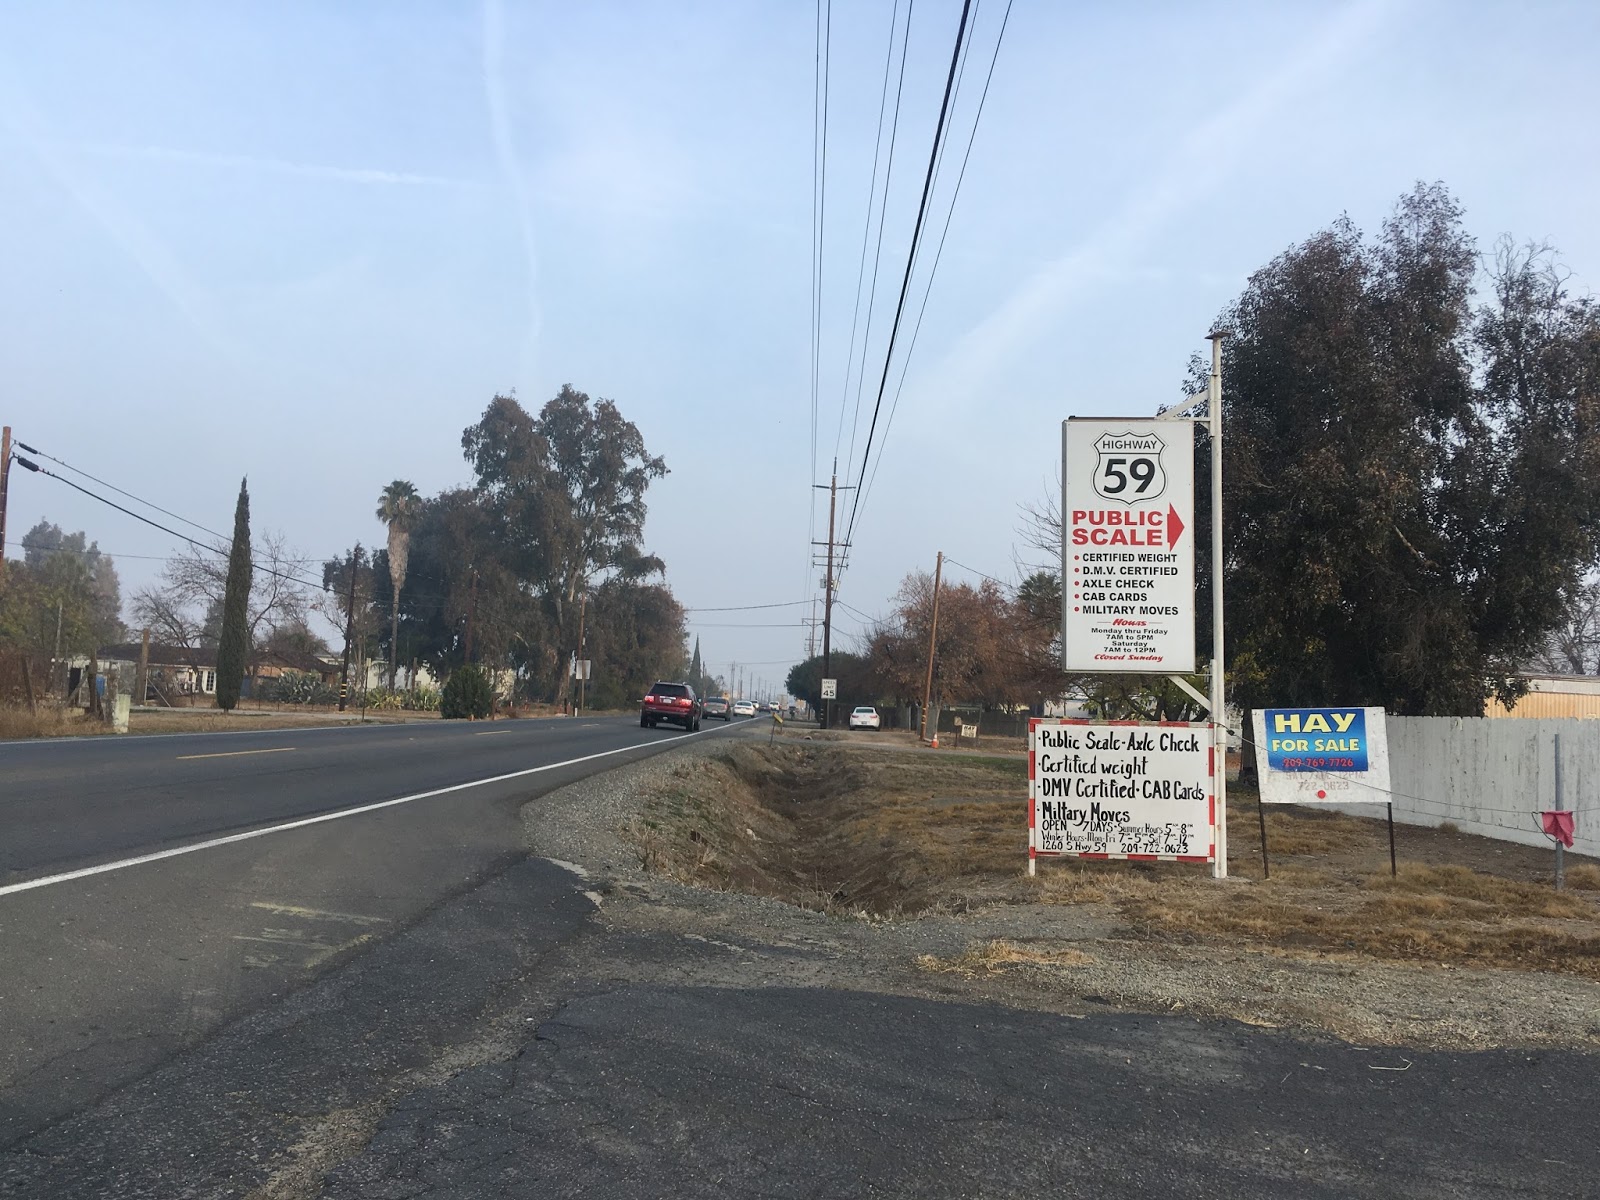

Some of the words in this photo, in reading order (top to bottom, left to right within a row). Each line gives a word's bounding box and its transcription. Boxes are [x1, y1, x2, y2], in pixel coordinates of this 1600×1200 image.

[1102, 440, 1158, 450] HIGHWAY
[1103, 458, 1156, 494] 59
[1072, 510, 1163, 526] PUBLIC
[1072, 528, 1163, 546] SCALE
[1082, 553, 1135, 562] CERTIFIED
[1138, 554, 1178, 563] WEIGHT
[1082, 566, 1116, 575] D.M.V.
[1120, 567, 1178, 576] CERTIFIED
[1082, 579, 1112, 588] AXLE
[1115, 580, 1155, 589] CHECK
[1082, 592, 1106, 601] CAB
[1109, 592, 1148, 602] CARDS
[1082, 605, 1136, 615] MILITARY
[1139, 606, 1179, 616] MOVES
[1112, 618, 1148, 627] Hours
[1091, 627, 1122, 635] Monday
[1143, 628, 1169, 636] Friday
[1112, 640, 1148, 648] Saturday
[1094, 653, 1126, 661] Closed
[1127, 654, 1163, 663] Sunday
[823, 689, 835, 697] 45
[1274, 713, 1356, 733] HAY
[1042, 730, 1080, 750] Public
[1160, 733, 1200, 752] Check
[1271, 739, 1309, 752] FOR
[1315, 738, 1360, 752] SALE
[1041, 754, 1097, 774] Certified
[1101, 756, 1149, 779] weight
[1283, 757, 1354, 768] 209-769-7726
[1042, 777, 1072, 797] DMV
[1142, 780, 1171, 800] CAB
[1173, 780, 1205, 801] Cards
[1090, 802, 1130, 822] Moves
[1042, 819, 1068, 831] OPEN
[1042, 840, 1063, 851] 1260
[1066, 841, 1073, 851] S
[1075, 841, 1092, 853] Hwy
[1094, 841, 1107, 853] 59
[1120, 842, 1189, 855] 209-722-0623
